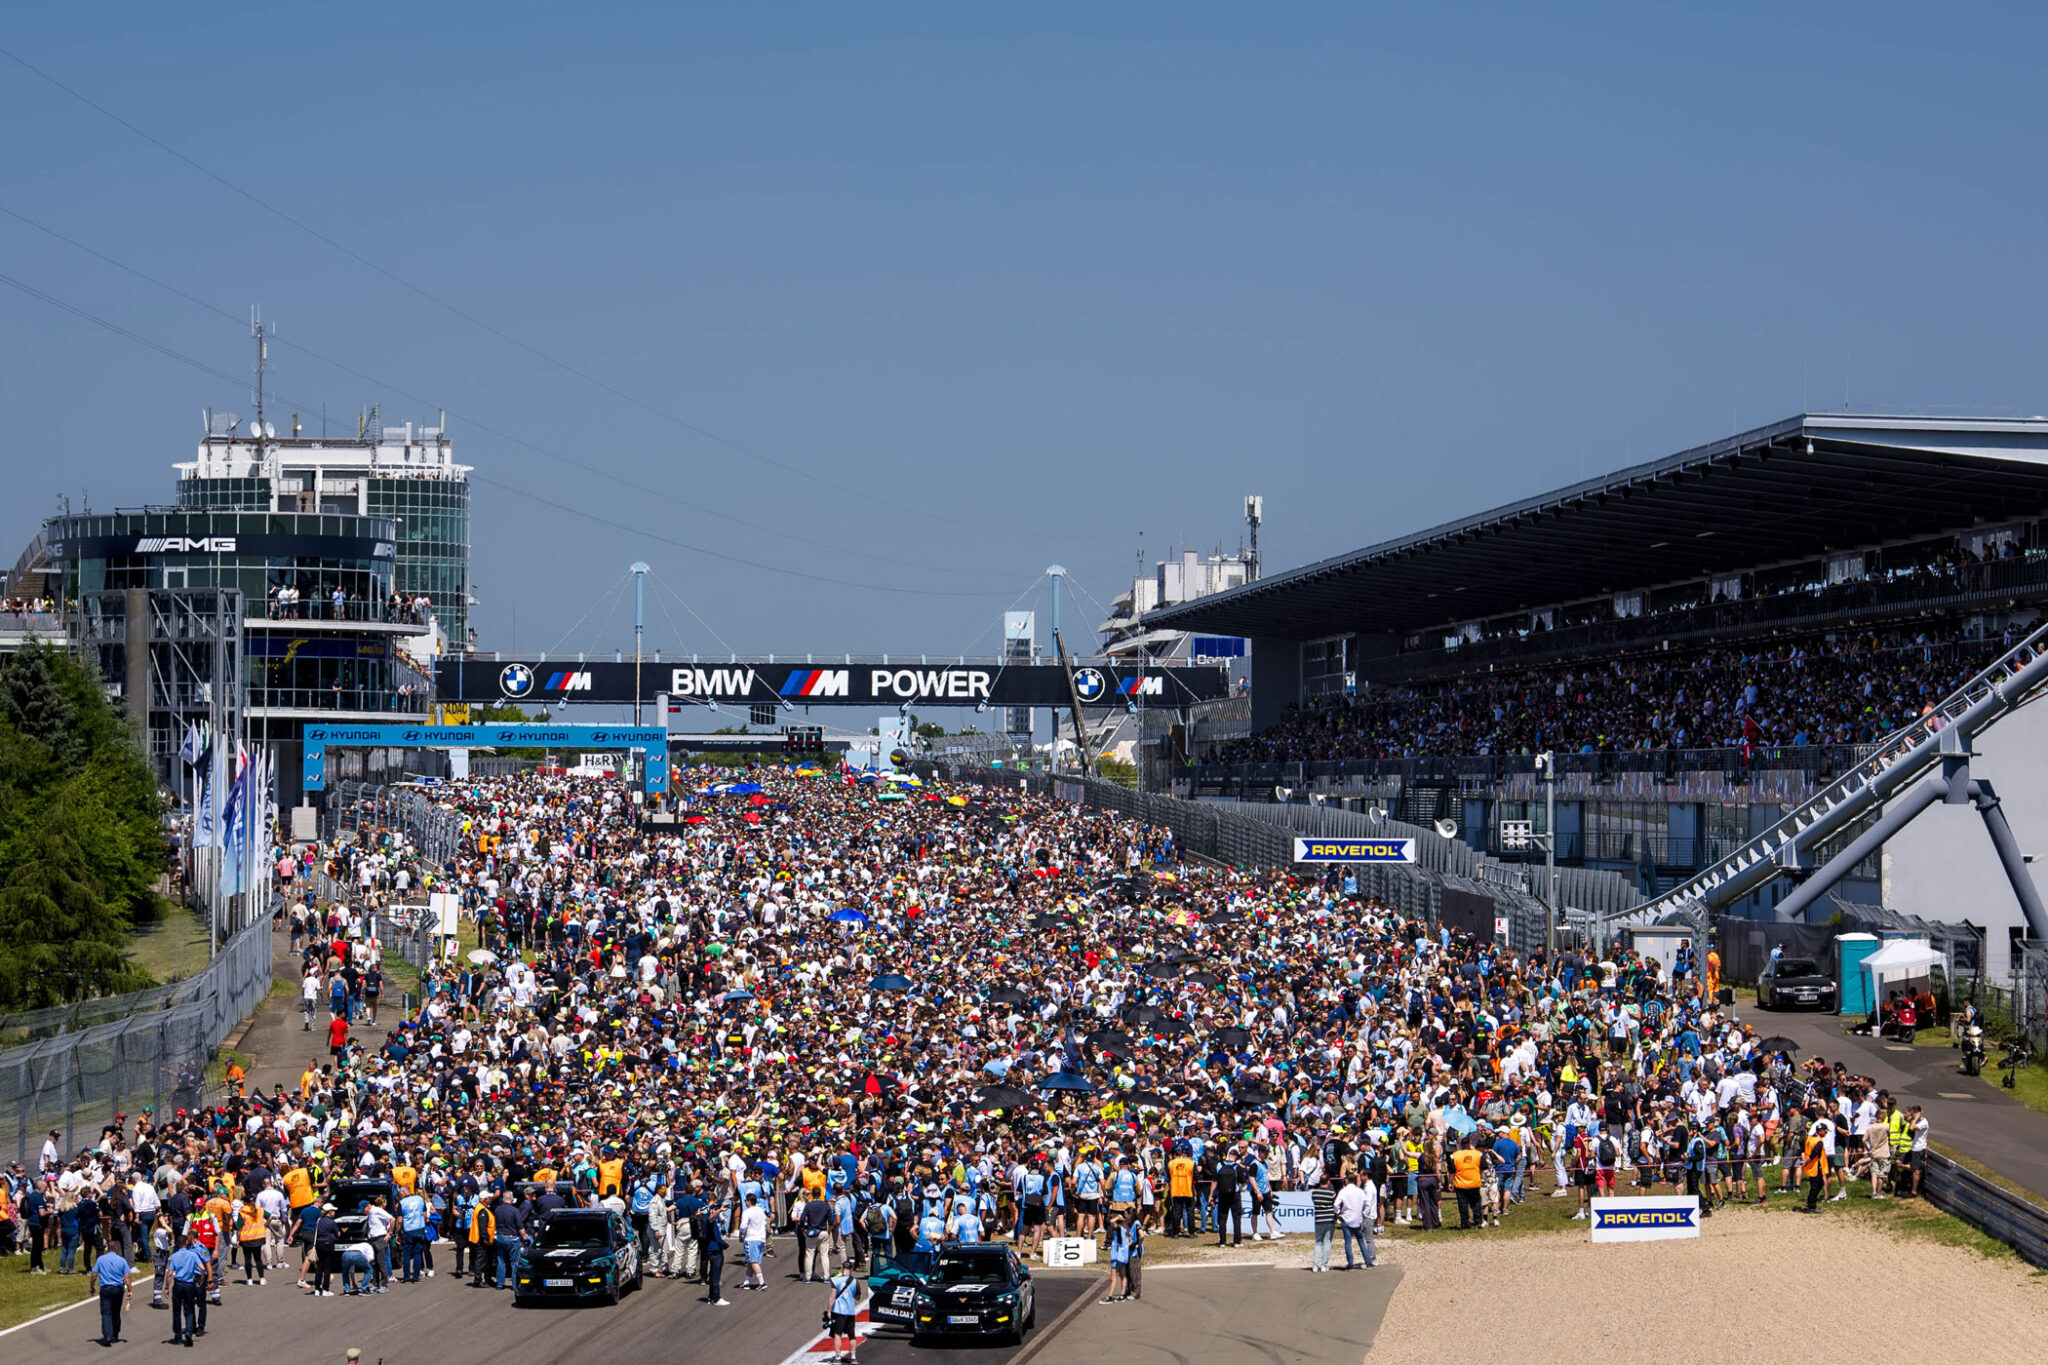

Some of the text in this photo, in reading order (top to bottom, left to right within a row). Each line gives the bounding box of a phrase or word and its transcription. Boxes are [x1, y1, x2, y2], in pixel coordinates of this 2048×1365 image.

[160, 537, 236, 552] AMG
[672, 669, 755, 695] BMW
[871, 670, 991, 697] POWER
[445, 703, 468, 715] ADAC
[330, 731, 663, 742] HYUNDAI HYUNDAI HYUNDAI HYUNDAI
[584, 755, 610, 766] H&R
[1311, 844, 1398, 856] RAVENOL
[1603, 1212, 1686, 1225] RAVENOL
[1064, 1243, 1080, 1261] 10
